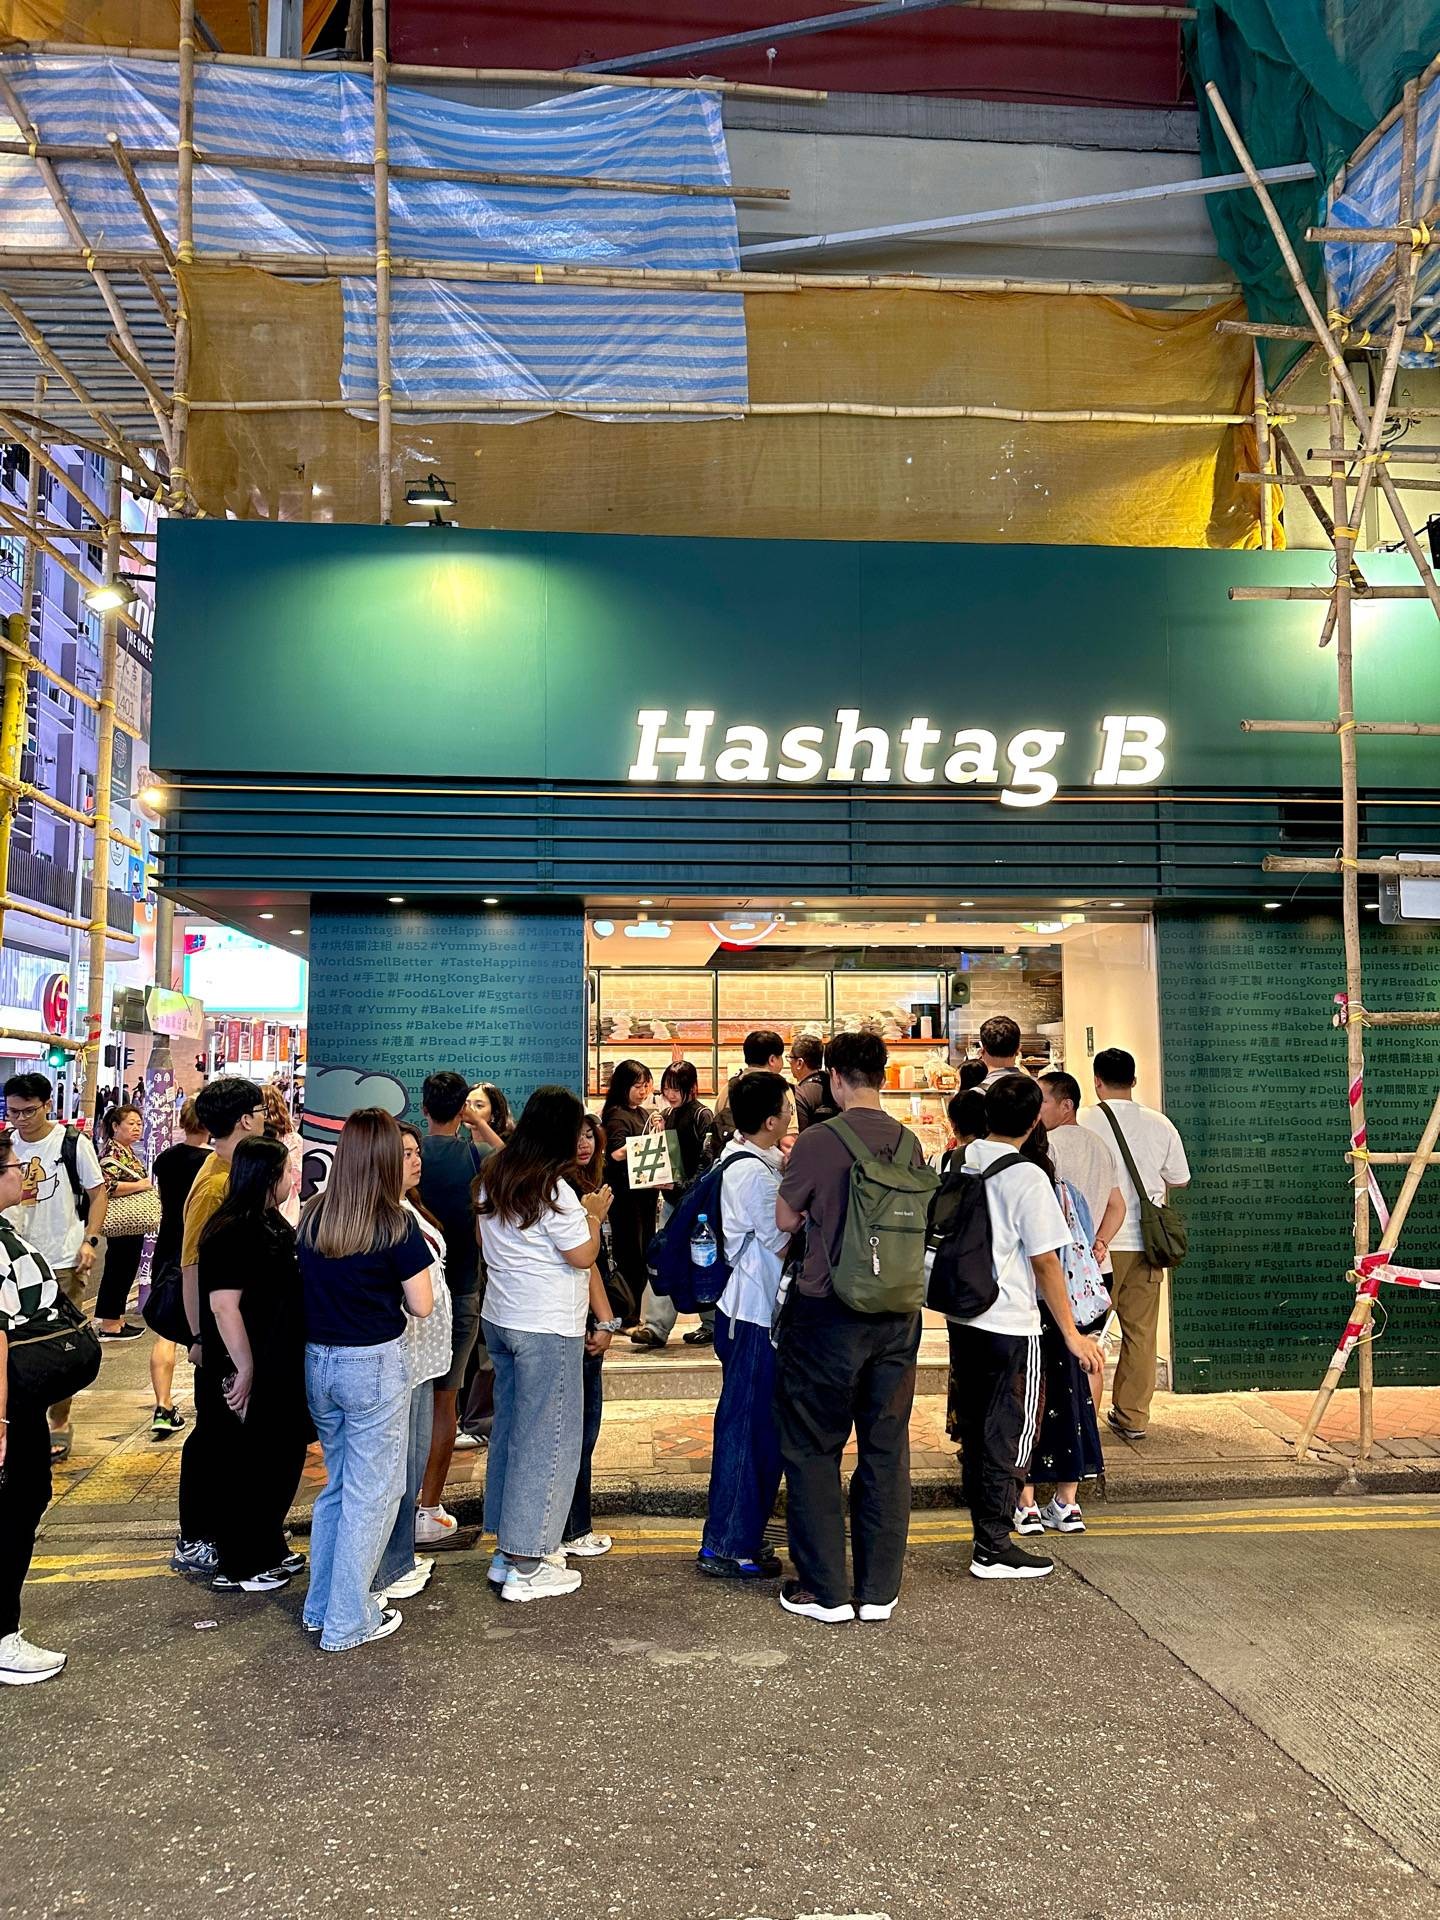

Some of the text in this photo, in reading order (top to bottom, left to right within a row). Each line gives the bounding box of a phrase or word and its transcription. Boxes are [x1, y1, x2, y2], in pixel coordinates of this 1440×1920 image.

[628, 708, 1168, 808] Hashtag B
[332, 926, 401, 937] #HashtagB
[406, 926, 515, 938] #TasteHappiness
[396, 941, 429, 950] #852
[430, 942, 526, 953] #YummyBread
[1259, 945, 1288, 955] #852
[440, 958, 549, 970] #TasteHappiness
[403, 972, 524, 985] #HongKongBakery
[330, 988, 384, 998] #Foodie
[388, 989, 475, 999] #Food&Lover
[478, 990, 539, 1002] #Eggtarts
[1199, 991, 1250, 1001] #Foodie
[358, 1005, 417, 1017] #Yummy
[421, 1005, 487, 1015] #BakeLife
[490, 1005, 567, 1015] #SmellGood
[1226, 1007, 1281, 1018] #Yummy
[406, 1021, 463, 1031] #Bakebe
[1165, 1022, 1269, 1033] #TasteHappiness
[1271, 1022, 1324, 1032] #Bakebe
[420, 1036, 467, 1046] #Bread
[469, 1036, 514, 1046] #手工製
[1285, 1037, 1328, 1047] #Bread
[372, 1053, 435, 1065] #Eggtarts
[438, 1053, 507, 1063] #Delicious
[1243, 1053, 1300, 1065] #Eggtarts
[460, 1069, 501, 1079] #Shop
[1248, 1068, 1321, 1079] #WellBaked
[1184, 1085, 1249, 1095] #Delicious
[1251, 1085, 1306, 1096] #Yummy
[1209, 1100, 1257, 1109] #Bloom
[1260, 1100, 1317, 1111] #Eggtarts
[1366, 1100, 1420, 1110] #Yummy
[1184, 1117, 1247, 1126] #BakeLife
[1250, 1117, 1322, 1126] #LifeIsGood
[1209, 1132, 1274, 1144] #HashtagB
[1271, 1148, 1300, 1158] #852
[1211, 1196, 1262, 1205] #Foodie
[1265, 1195, 1347, 1205] #Food&Lover
[1238, 1211, 1293, 1222] #Yummy
[1284, 1226, 1337, 1236] #Bakebe
[1297, 1242, 1340, 1252] #Bread
[1254, 1259, 1312, 1271] #Eggtarts
[1260, 1274, 1333, 1285] #WellBaked
[1196, 1291, 1261, 1301] #Delicious
[1264, 1290, 1318, 1302] #Yummy
[1221, 1307, 1269, 1317] #Bloom
[1272, 1306, 1329, 1319] #Eggtarts
[1183, 1322, 1246, 1332] #BakeLife
[1249, 1321, 1322, 1332] #LifeIsGood
[1208, 1338, 1274, 1349] #HashtagB
[1269, 1353, 1298, 1363] #852
